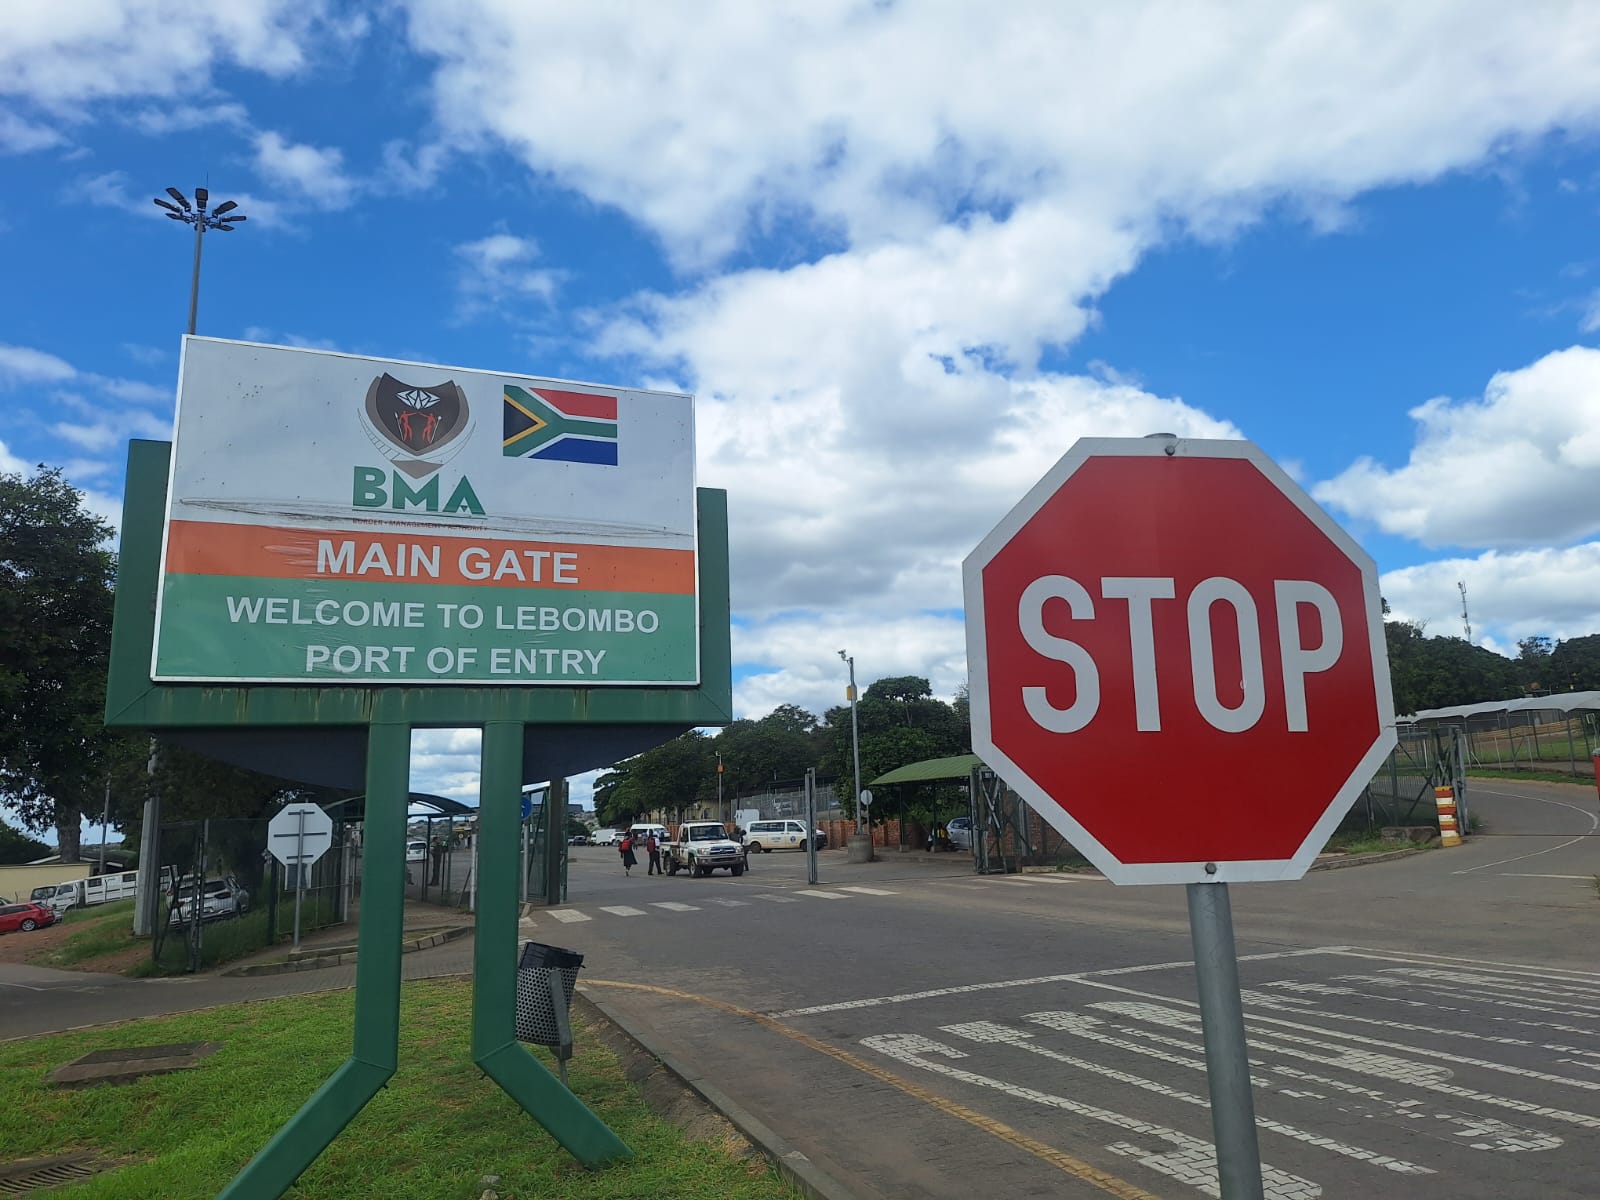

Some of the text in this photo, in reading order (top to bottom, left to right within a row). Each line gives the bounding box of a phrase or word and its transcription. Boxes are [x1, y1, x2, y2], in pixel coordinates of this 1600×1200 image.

[352, 465, 486, 515] BMA
[317, 539, 579, 584] MAIN GATE
[226, 596, 659, 634] WELCOME TO LEBOMBO
[306, 644, 606, 675] PORT OF ENTRY
[1018, 574, 1344, 734] STOP
